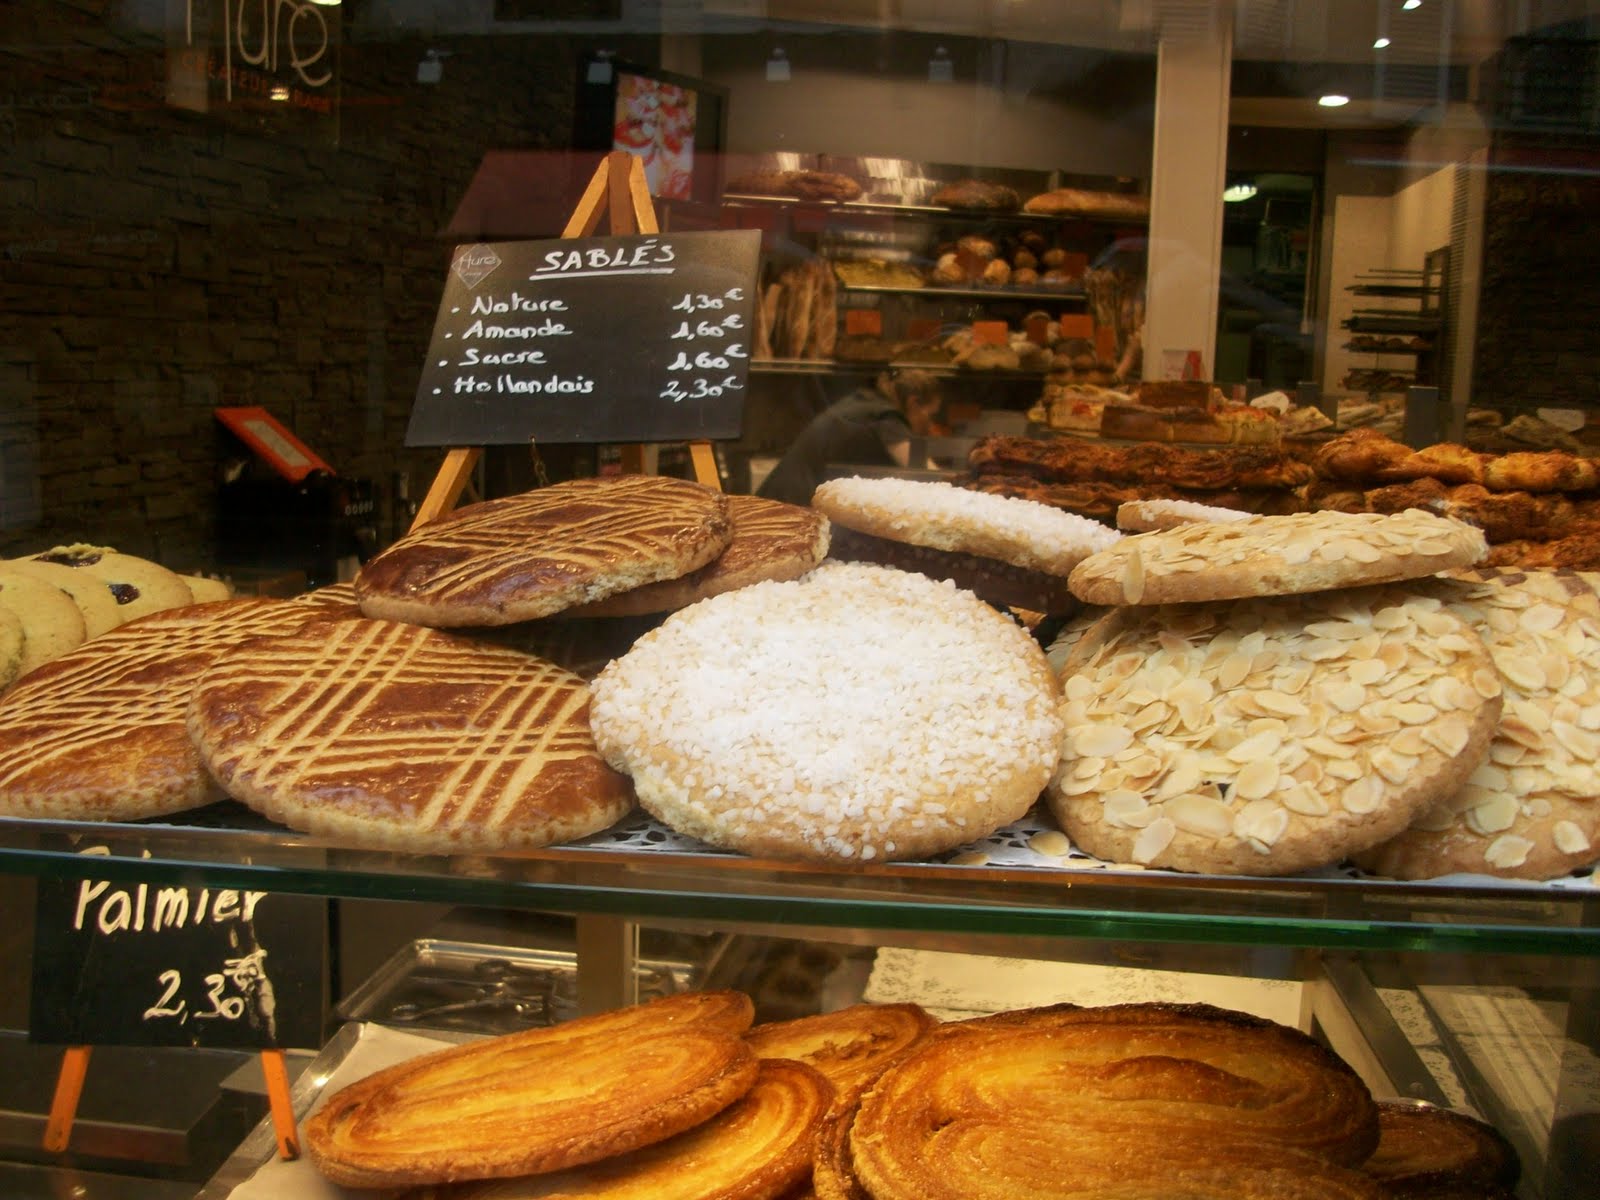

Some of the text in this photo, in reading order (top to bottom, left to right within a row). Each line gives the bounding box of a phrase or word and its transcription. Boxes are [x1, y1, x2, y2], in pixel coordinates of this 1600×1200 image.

[536, 239, 676, 272] SABLÉS
[471, 292, 569, 316] Nature
[462, 319, 573, 340] Amande
[458, 348, 548, 366] Sucre
[454, 374, 594, 394] Hollandais
